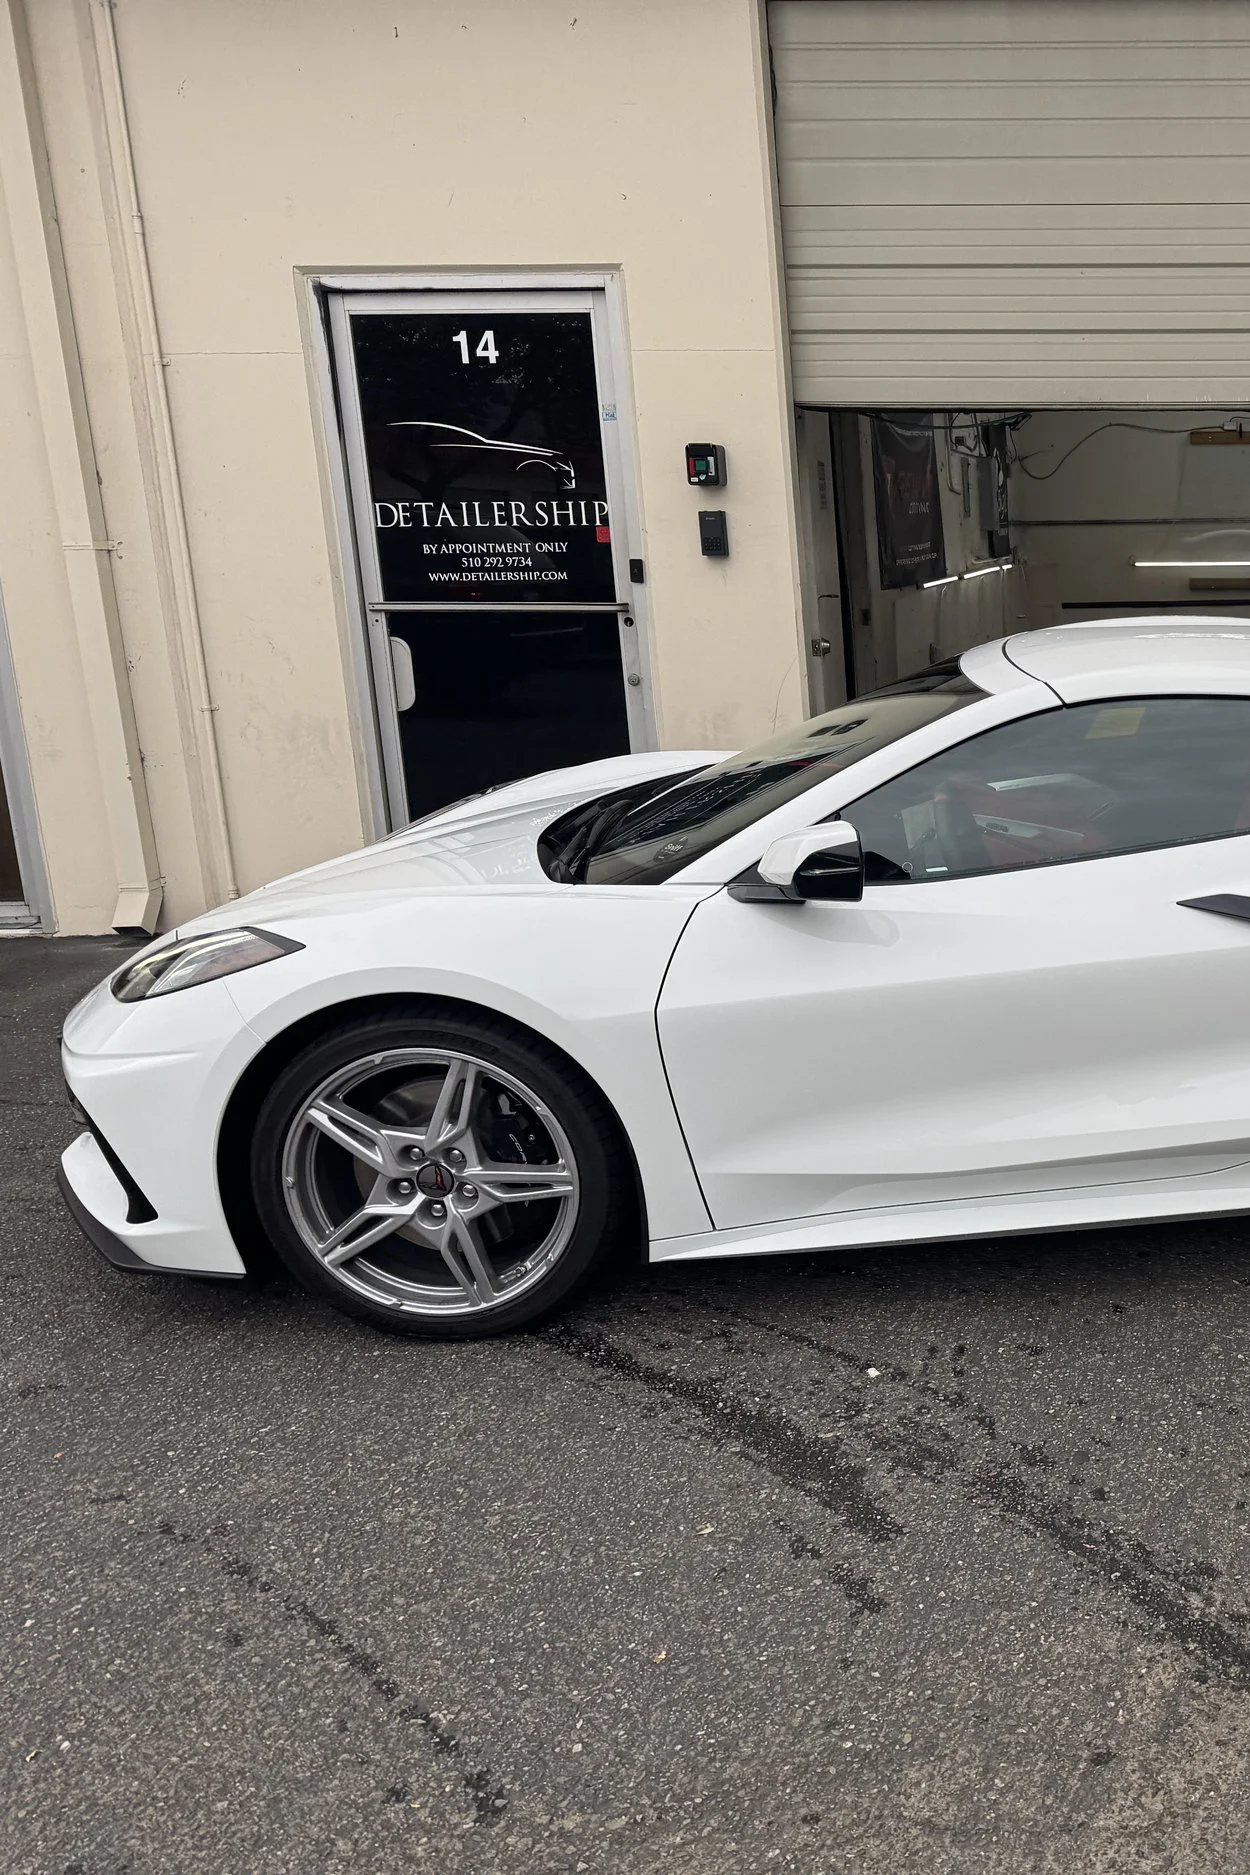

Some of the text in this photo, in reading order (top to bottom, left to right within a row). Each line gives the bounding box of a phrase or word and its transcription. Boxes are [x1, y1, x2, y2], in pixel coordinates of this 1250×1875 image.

[452, 330, 500, 364] 14
[374, 500, 609, 529] DETAILERSHIP
[423, 542, 568, 554] BY APPOINTMENT ONLY
[461, 556, 532, 568] 510 292 9734
[428, 571, 568, 582] WWW.DETAILERSHIP.COM
